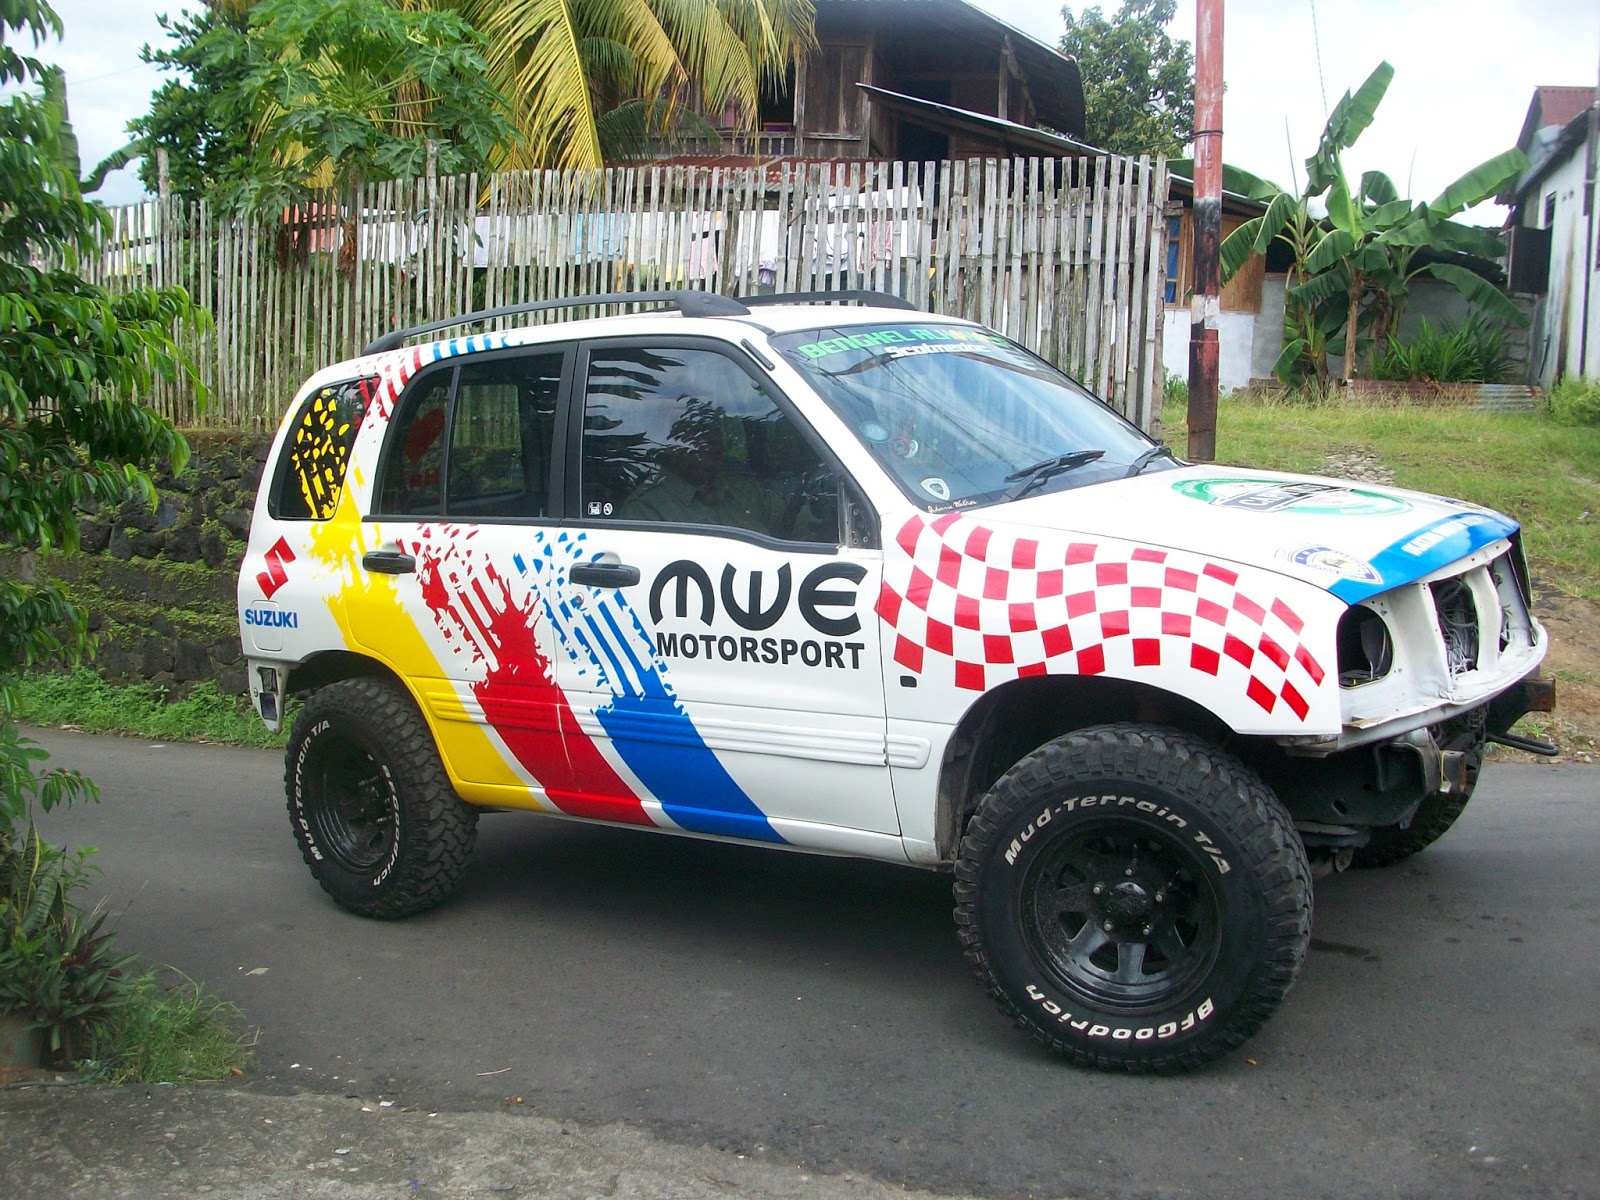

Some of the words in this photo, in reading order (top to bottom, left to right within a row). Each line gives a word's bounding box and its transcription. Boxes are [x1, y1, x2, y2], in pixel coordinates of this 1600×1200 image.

[798, 330, 916, 359] BENGHEL
[649, 559, 869, 636] MWE
[245, 609, 298, 628] SUZUKI
[656, 632, 865, 669] MOTORSPORT
[311, 719, 331, 738] T/A
[1004, 795, 1188, 866] Mud-Terrain
[1193, 830, 1231, 874] T/A
[1026, 984, 1214, 1040] BFGoodrich
